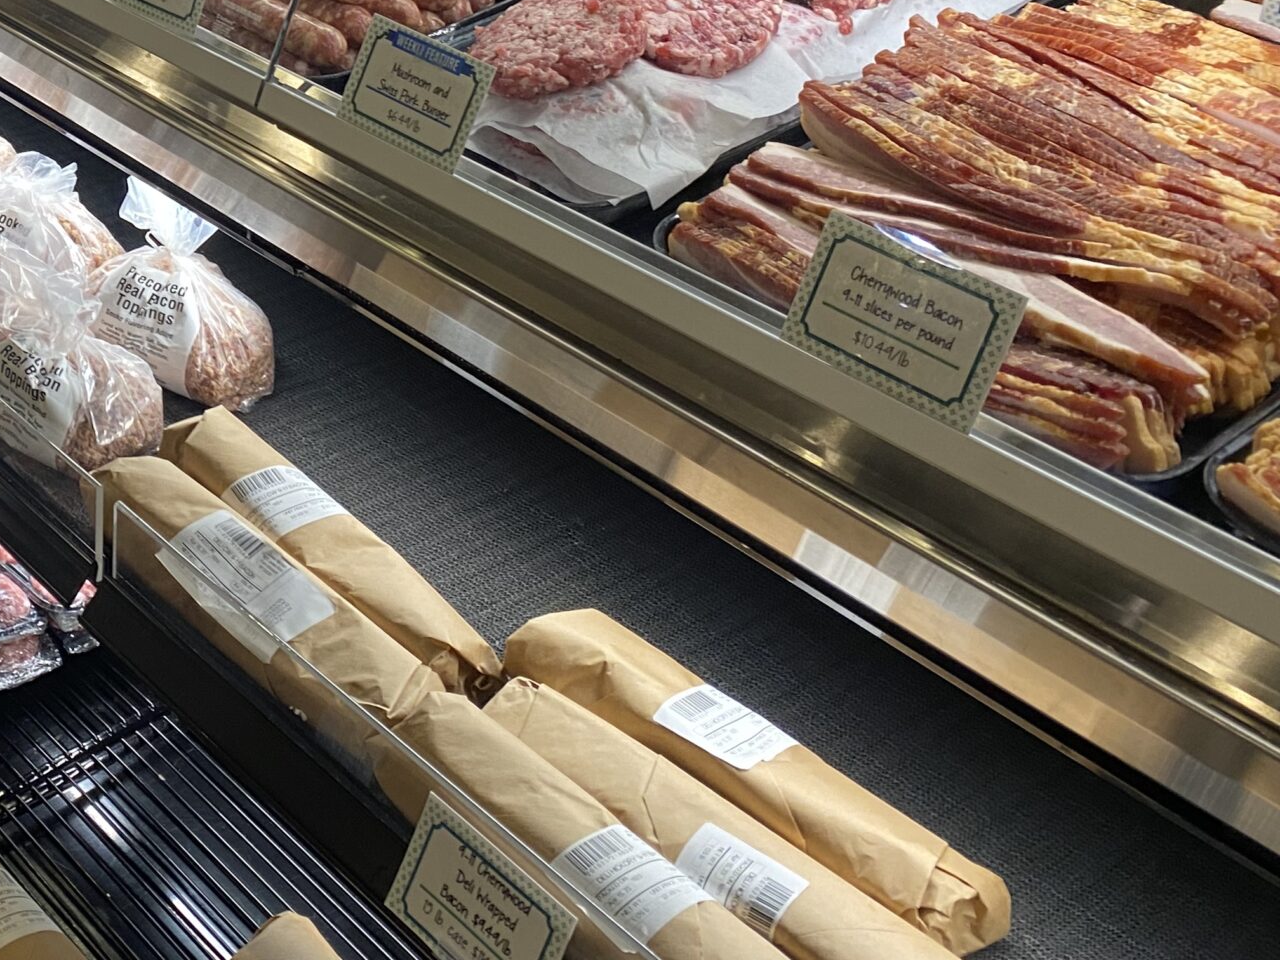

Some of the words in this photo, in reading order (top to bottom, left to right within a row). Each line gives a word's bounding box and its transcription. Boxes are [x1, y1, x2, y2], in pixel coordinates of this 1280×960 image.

[396, 34, 424, 57] WEEKLY
[424, 45, 462, 73] FEATURE
[376, 78, 399, 98] Swiss
[399, 89, 420, 108] Pork
[421, 100, 452, 121] Burger
[391, 62, 432, 91] Mushroom
[433, 85, 452, 100] and
[116, 277, 146, 300] Real
[850, 265, 923, 310] Cherrywood
[924, 298, 964, 331] Bacon
[863, 297, 894, 323] slices
[894, 316, 917, 331] per
[918, 325, 956, 352] pound
[0, 344, 28, 369] Real
[0, 359, 47, 402] Toppings
[440, 883, 469, 919] Bacon
[456, 869, 476, 894] Deli
[476, 887, 520, 933] Wrapped
[477, 862, 533, 917] Cherrywood
[446, 926, 469, 950] case
